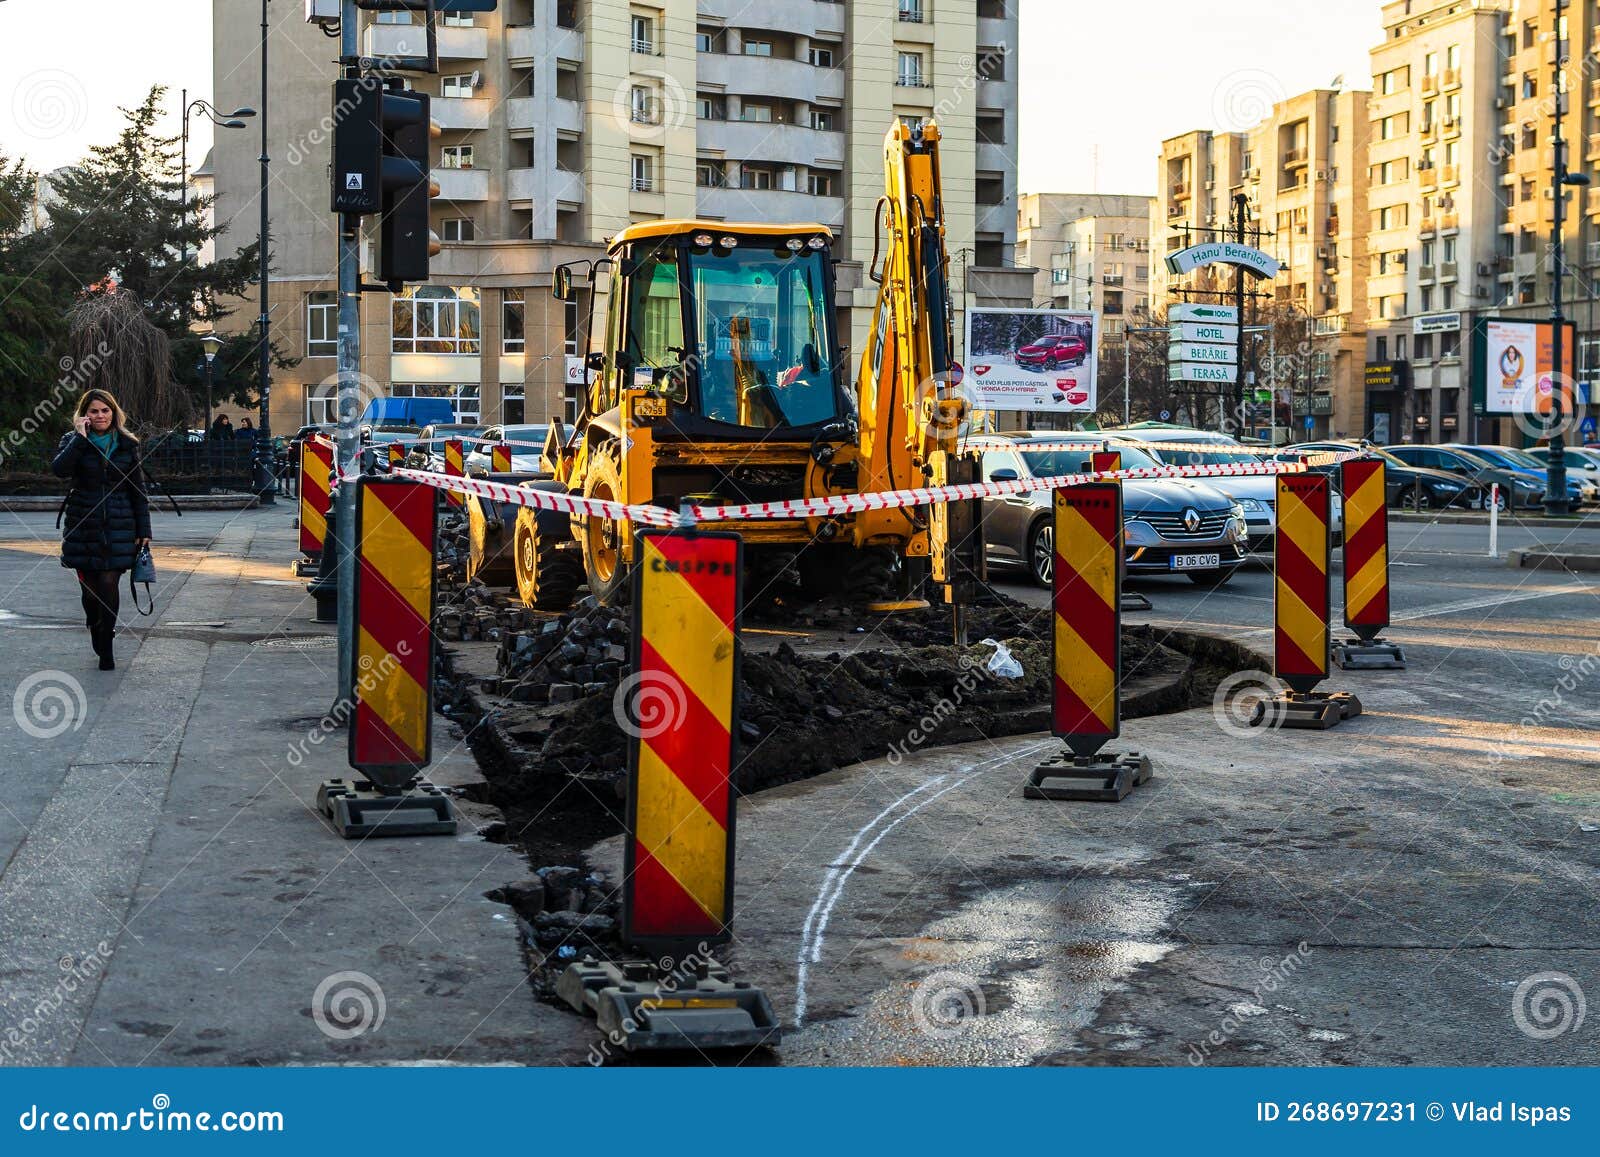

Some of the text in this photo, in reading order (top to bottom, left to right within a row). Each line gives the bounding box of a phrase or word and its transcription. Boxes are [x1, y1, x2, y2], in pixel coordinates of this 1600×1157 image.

[1225, 246, 1268, 268] Berarilor
[1214, 310, 1232, 318] 100m
[1196, 328, 1224, 339] HOTEL
[1176, 555, 1218, 566] B 06 CVG
